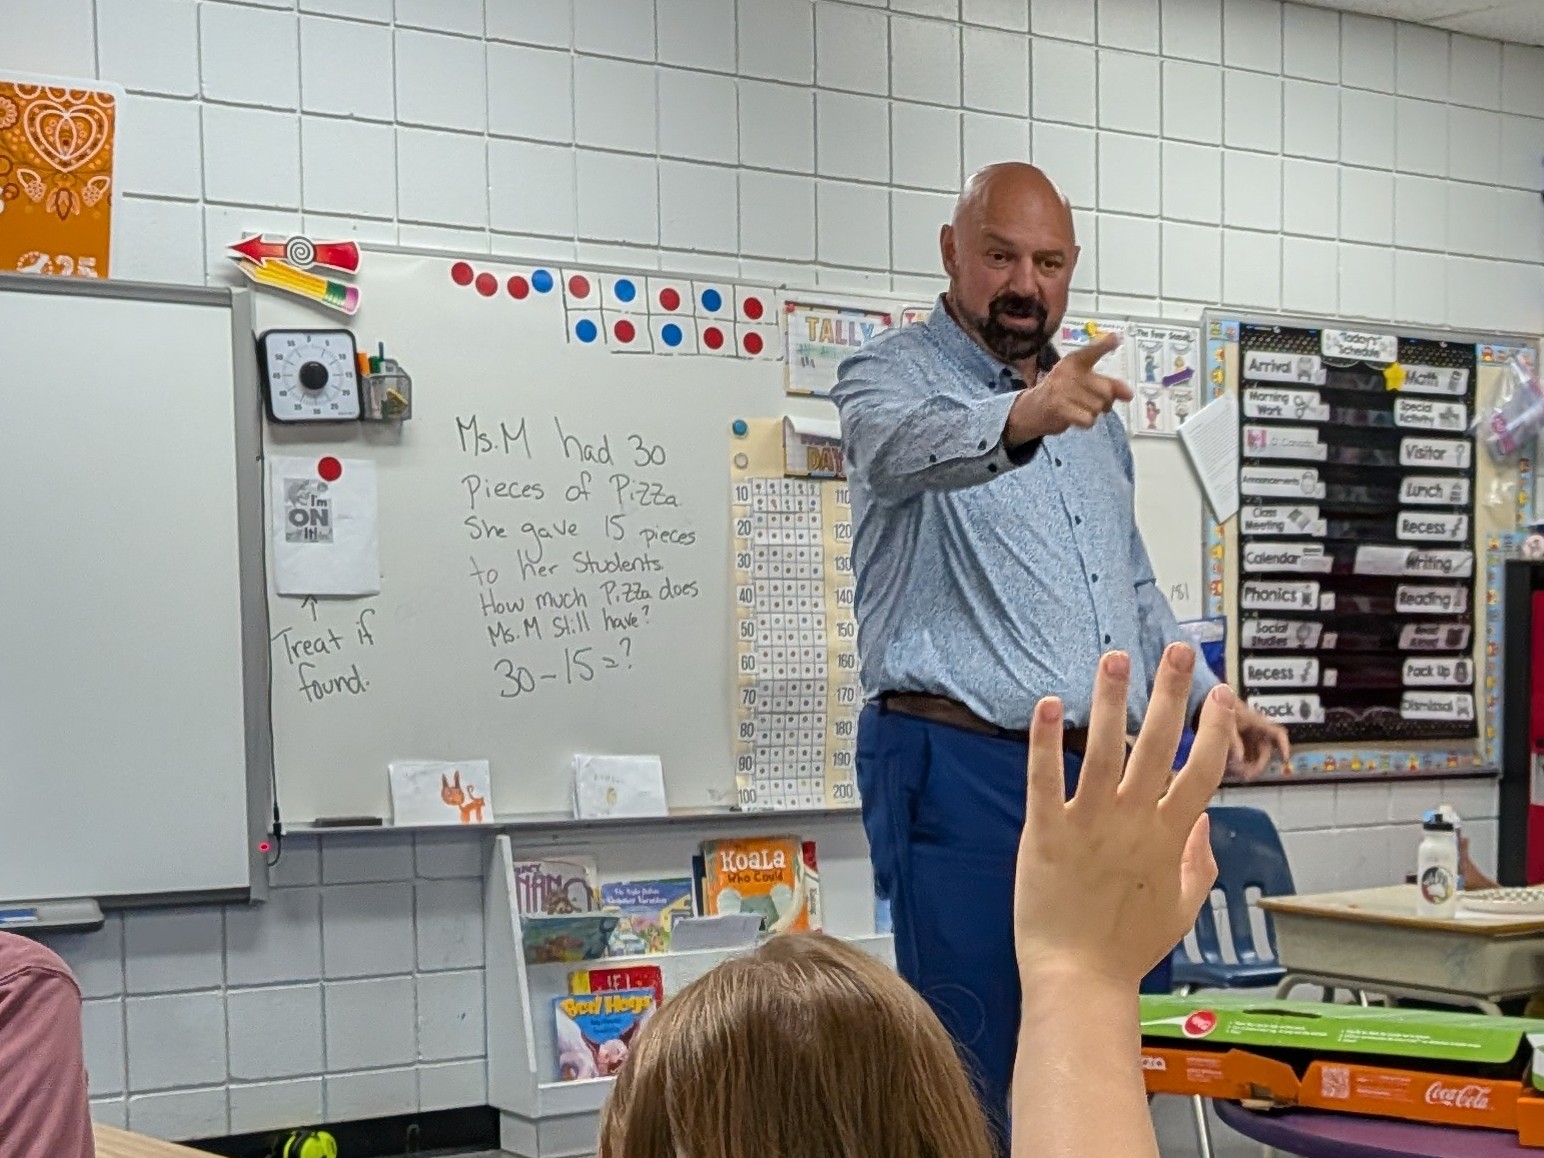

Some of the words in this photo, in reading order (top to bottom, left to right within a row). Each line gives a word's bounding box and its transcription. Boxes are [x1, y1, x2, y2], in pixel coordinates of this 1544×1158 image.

[805, 315, 875, 348] TALLY
[1248, 358, 1292, 374] Arrival
[554, 416, 614, 466] had
[627, 434, 666, 467] 30
[1405, 444, 1446, 461] Visitor
[565, 470, 592, 502] of
[736, 485, 749, 502] 10
[1406, 482, 1442, 498] Lunch
[310, 494, 328, 507] I'm
[835, 489, 851, 504] 110
[288, 507, 329, 528] ON
[737, 520, 751, 537] 20
[834, 524, 851, 539] 120
[1402, 519, 1446, 534] Recess
[464, 515, 508, 540] She
[520, 520, 579, 564] gave
[605, 513, 627, 541] 15
[737, 553, 751, 569] 30
[835, 557, 851, 571] 130
[1246, 551, 1301, 566] Calendar
[1405, 554, 1452, 574] Writing
[469, 556, 499, 587] to
[517, 549, 560, 582] her
[479, 588, 525, 617] How
[536, 587, 588, 610] much
[659, 577, 700, 601] does
[739, 588, 753, 604] 40
[835, 589, 854, 605] 140
[1244, 587, 1298, 603] Phonics
[271, 627, 344, 665] Treat
[355, 608, 376, 646] if
[740, 622, 755, 638] 50
[836, 622, 855, 637] 150
[741, 655, 755, 671] 60
[837, 654, 855, 669] 160
[1248, 665, 1294, 681] Recess
[742, 689, 757, 705] 70
[836, 687, 855, 702] 170
[740, 722, 755, 738] 80
[835, 720, 853, 735] 180
[738, 756, 753, 771] 90
[833, 752, 851, 767] 190
[738, 788, 757, 804] 100
[833, 784, 854, 799] 200
